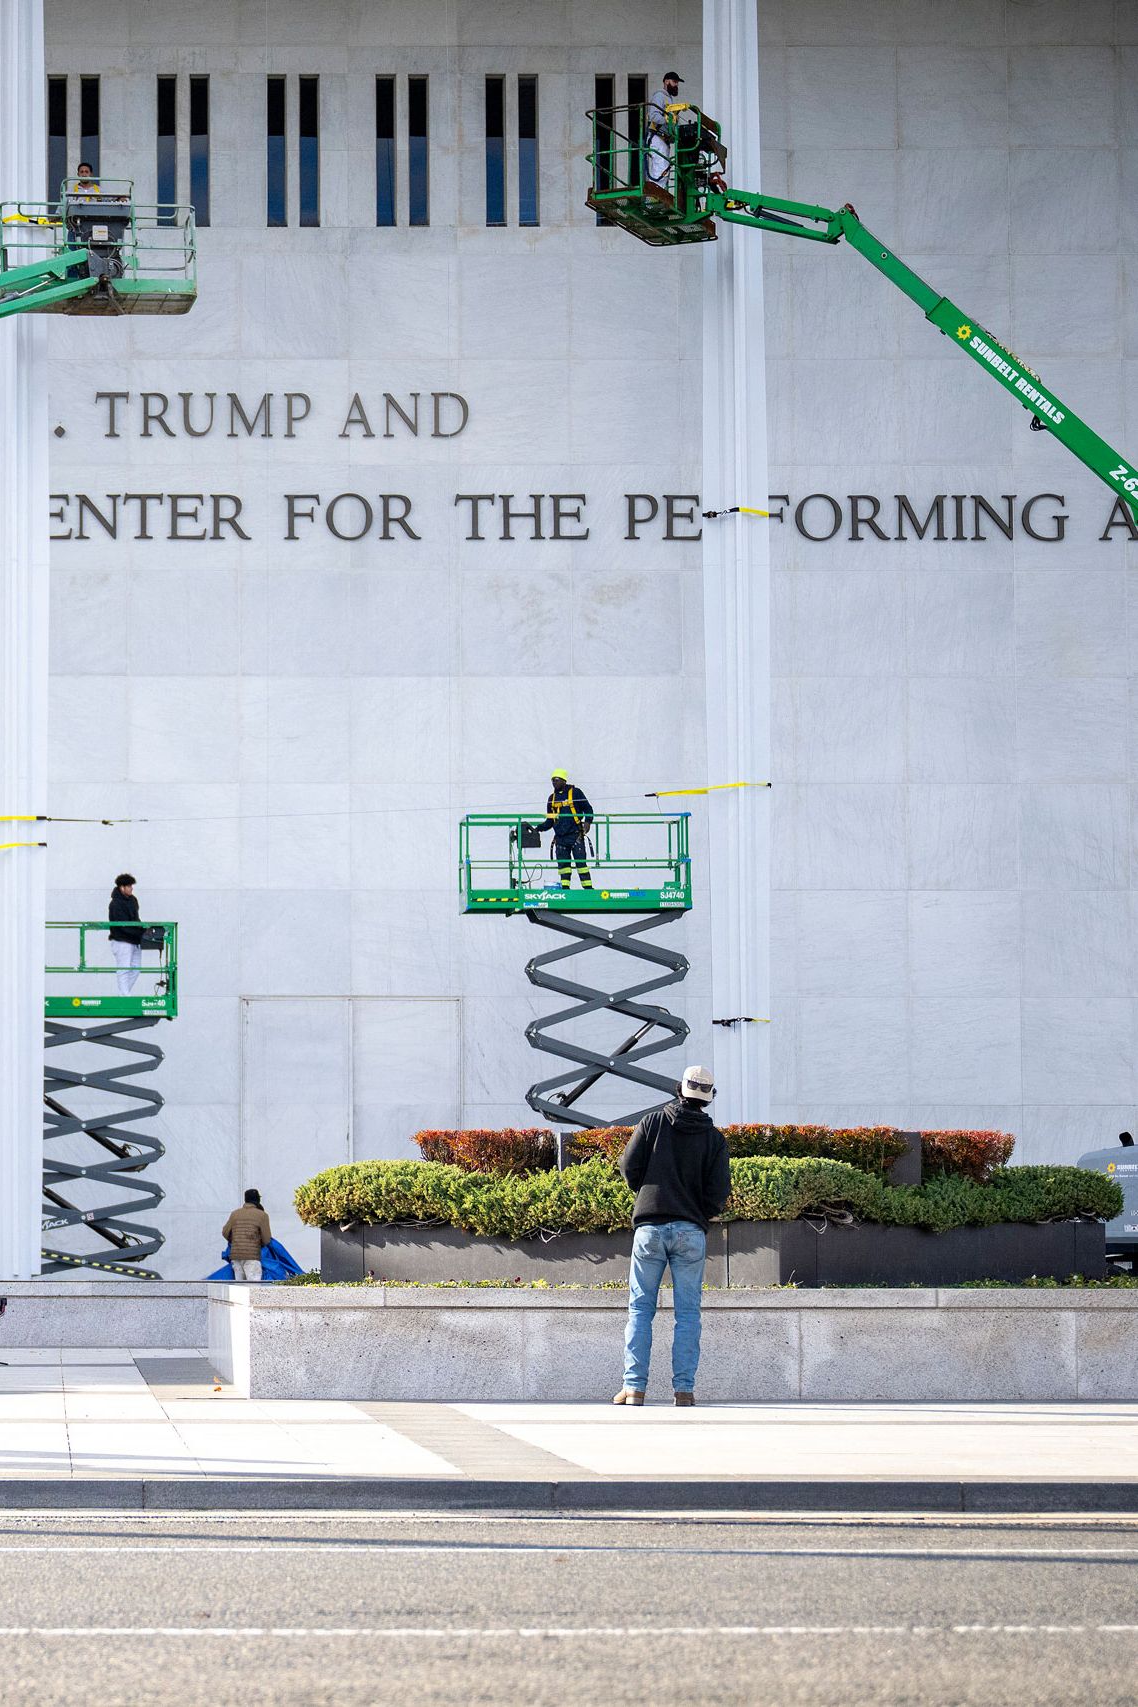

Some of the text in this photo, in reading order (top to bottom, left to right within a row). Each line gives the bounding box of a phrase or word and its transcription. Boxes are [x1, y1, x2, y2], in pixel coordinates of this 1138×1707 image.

[969, 336, 1065, 424] SUNBELT RENTALS
[95, 391, 312, 439] TRUMP
[337, 391, 470, 439] AND
[1109, 464, 1138, 501] Z-6
[49, 493, 253, 542] ENTER
[283, 492, 423, 542] FOR
[454, 492, 590, 541] THE
[624, 492, 1070, 543] PEFORMING
[524, 891, 566, 901] SKYJACK
[659, 891, 685, 899] SJ4740
